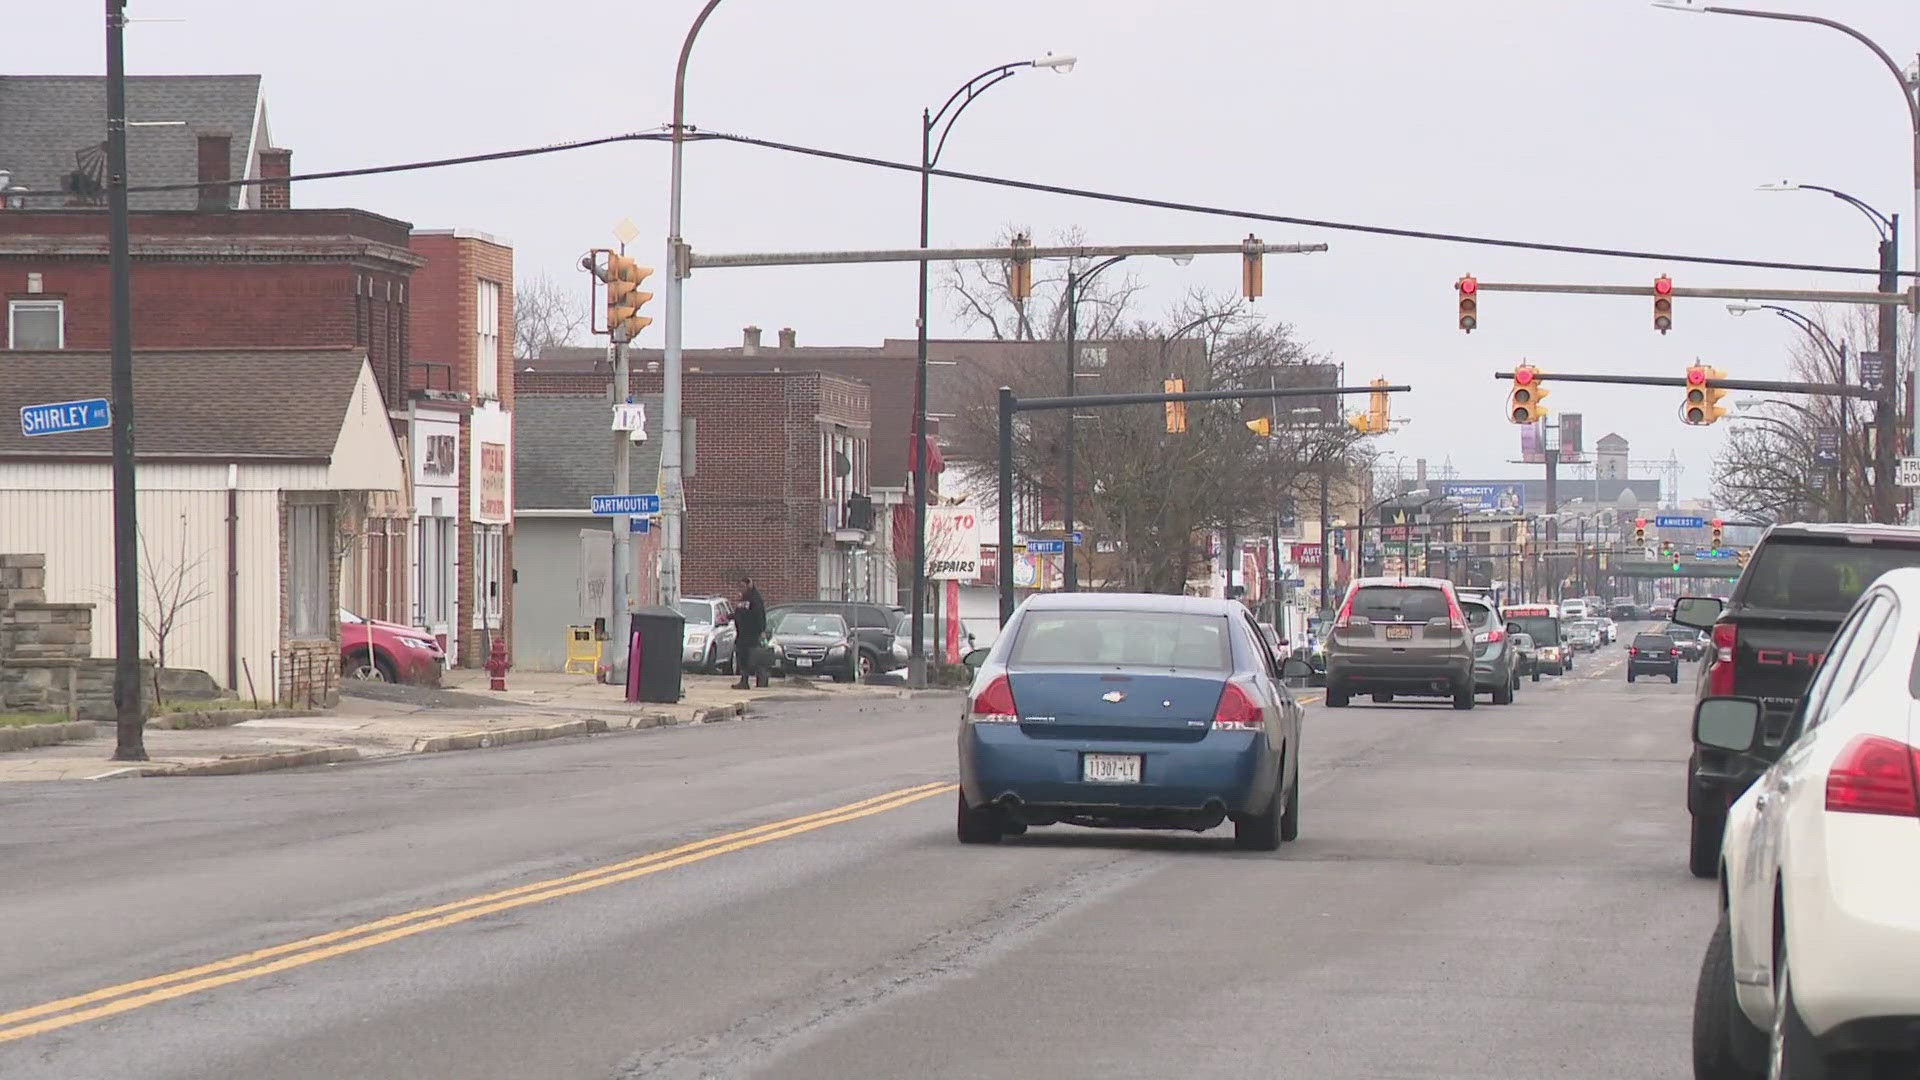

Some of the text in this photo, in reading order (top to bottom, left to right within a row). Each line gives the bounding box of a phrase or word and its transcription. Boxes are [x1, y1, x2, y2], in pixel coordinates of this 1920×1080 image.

[24, 405, 88, 431] SHIRLEY
[593, 499, 649, 513] DARTMOUTH
[1027, 542, 1054, 553] HEWITT
[929, 560, 976, 577] REPAIRS
